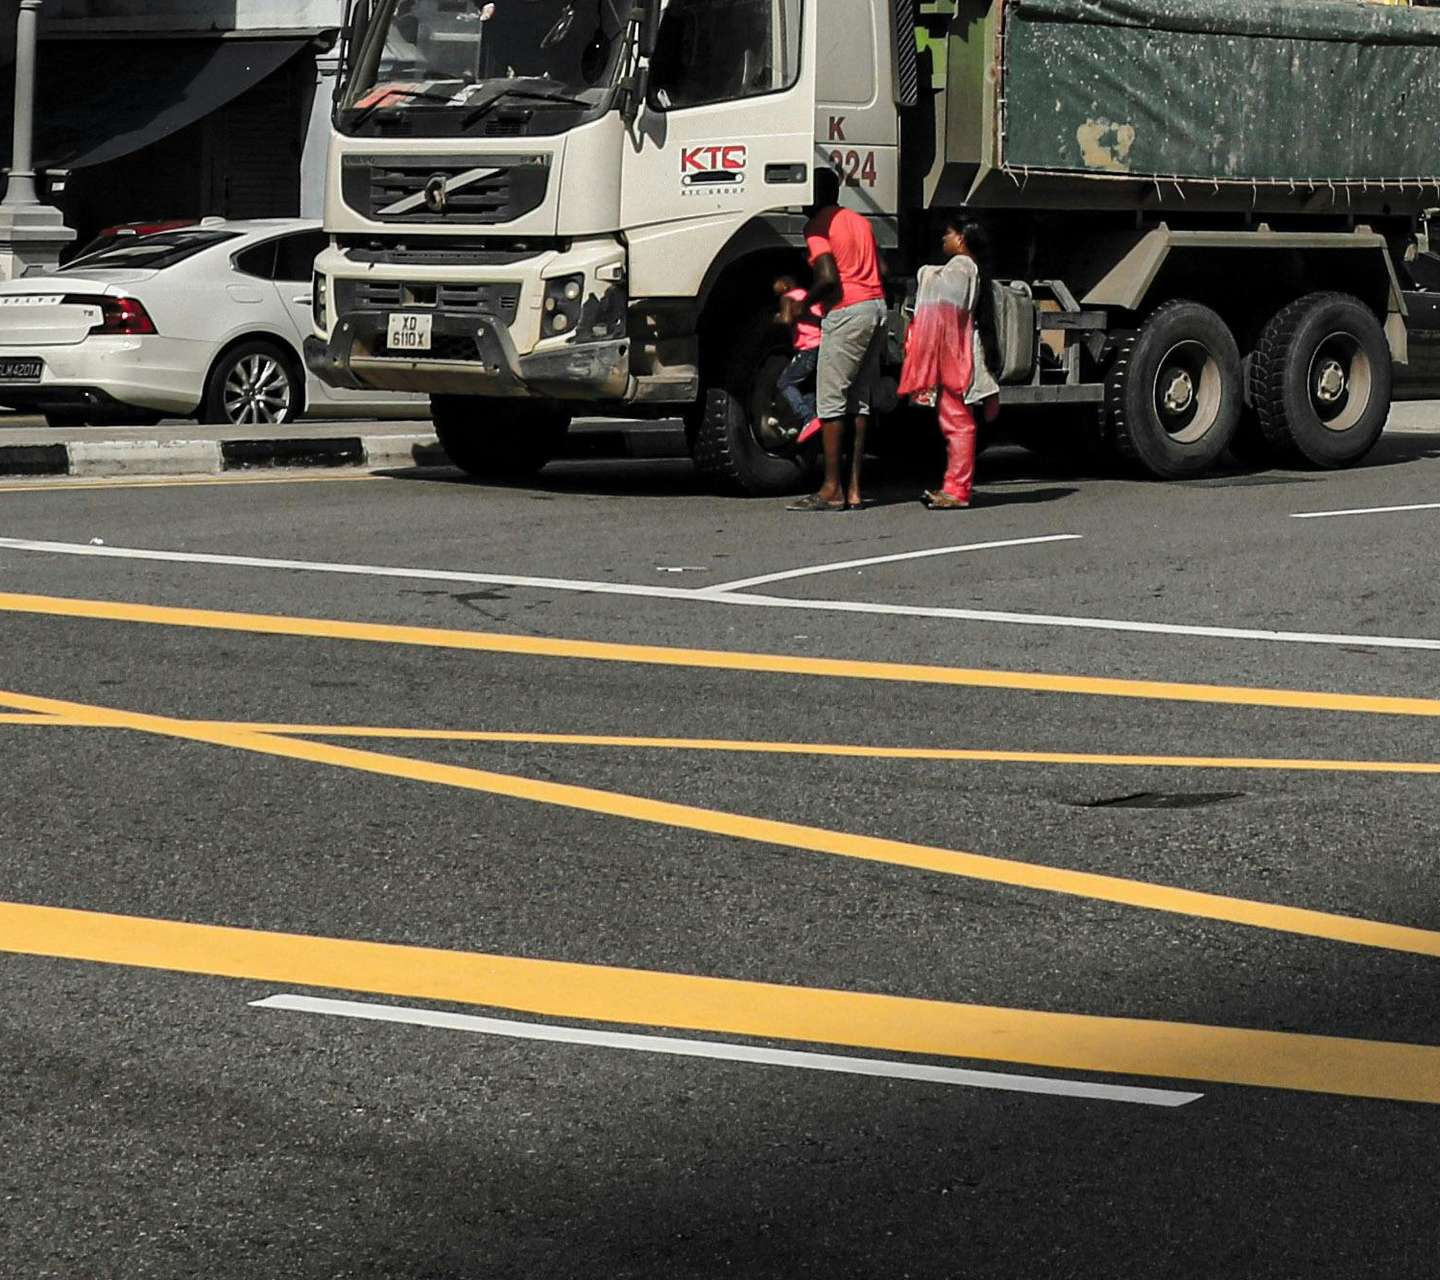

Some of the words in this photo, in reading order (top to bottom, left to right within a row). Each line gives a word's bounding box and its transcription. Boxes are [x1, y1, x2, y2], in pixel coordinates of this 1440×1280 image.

[829, 116, 846, 140] K
[681, 145, 746, 172] KTC
[402, 316, 417, 329] XD
[392, 332, 424, 347] 6110X
